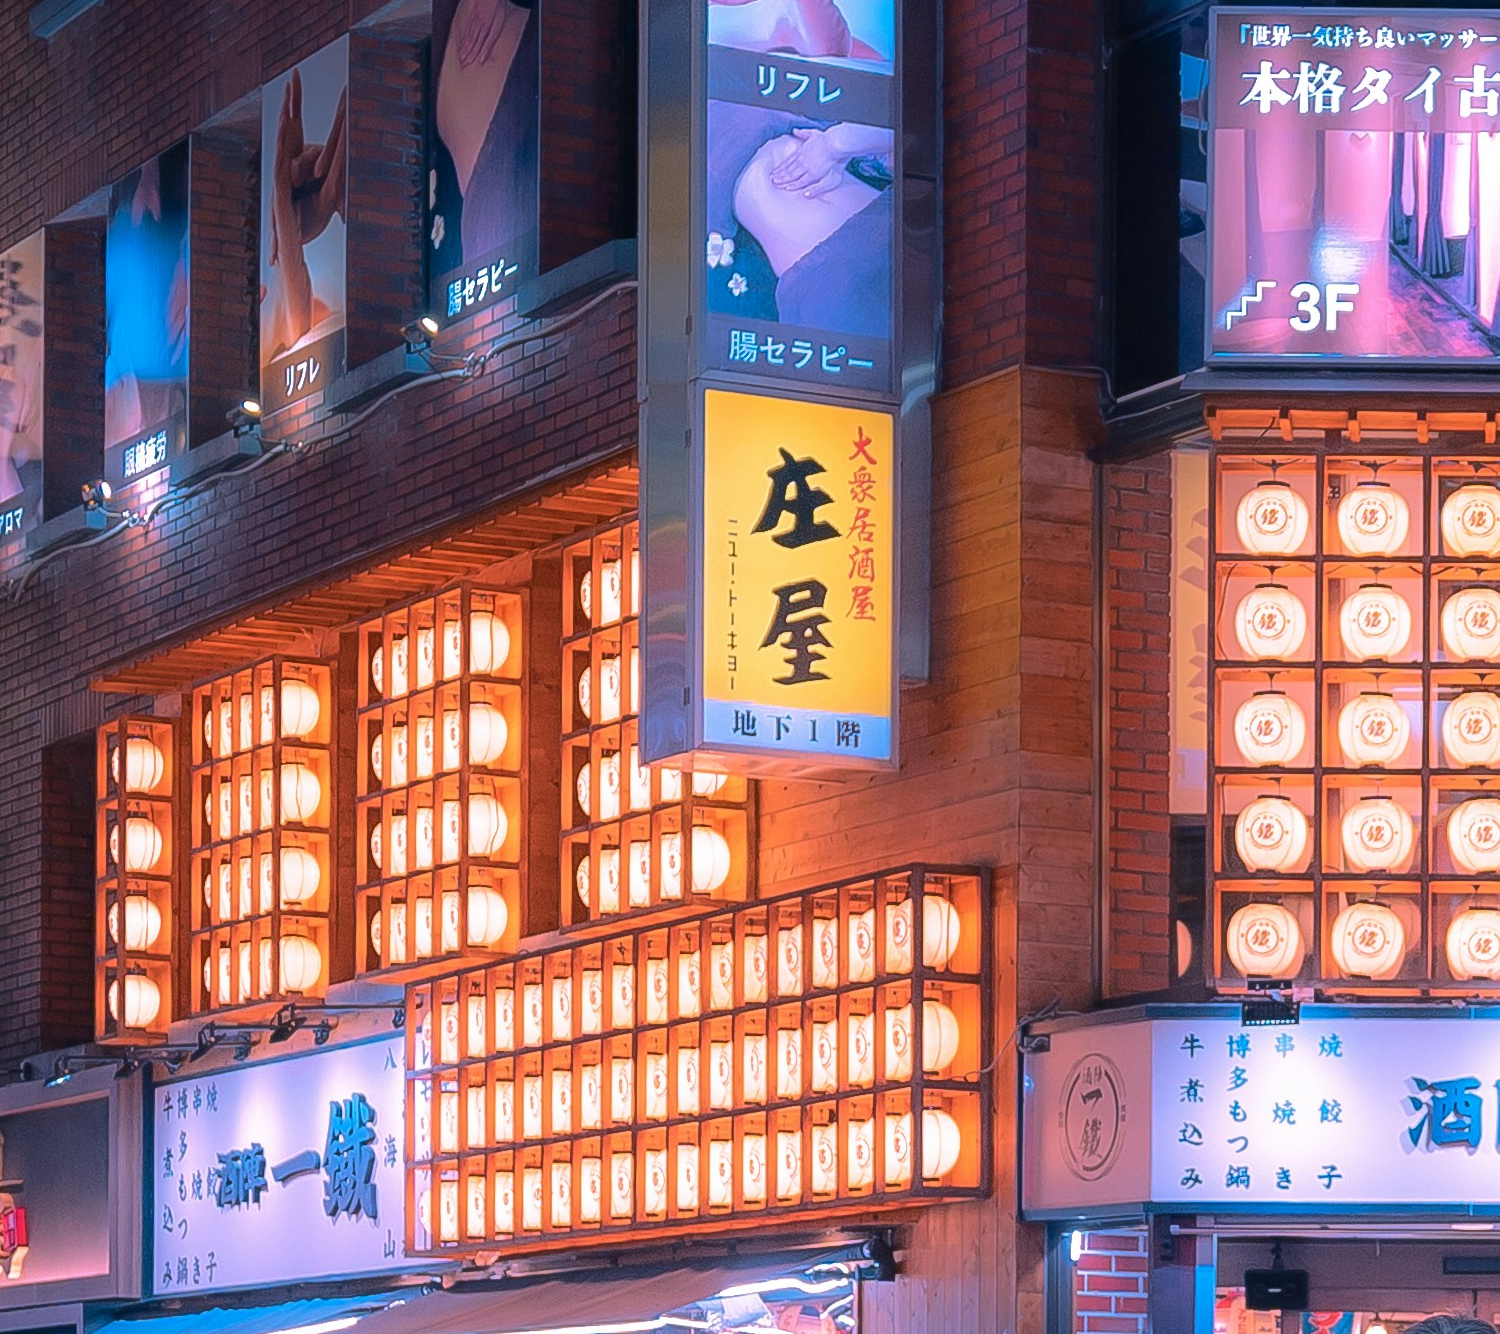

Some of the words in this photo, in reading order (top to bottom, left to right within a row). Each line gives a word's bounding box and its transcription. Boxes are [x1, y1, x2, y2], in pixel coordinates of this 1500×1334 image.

[753, 63, 844, 106] リフレ
[447, 259, 518, 318] 腸セラピー
[1287, 282, 1360, 333] 3F
[286, 357, 321, 396] リフレ
[728, 328, 876, 378] 腸セラピー
[750, 446, 843, 686] 庄屋
[846, 426, 877, 622] 大衆居酒屋
[732, 709, 861, 749] 地下1階
[1178, 1033, 1204, 1190] 牛煮込み
[1225, 1033, 1251, 1190] 博多もつ鍋
[1272, 1032, 1297, 1190] 串焼き
[1317, 1032, 1343, 1190] 焼餃子
